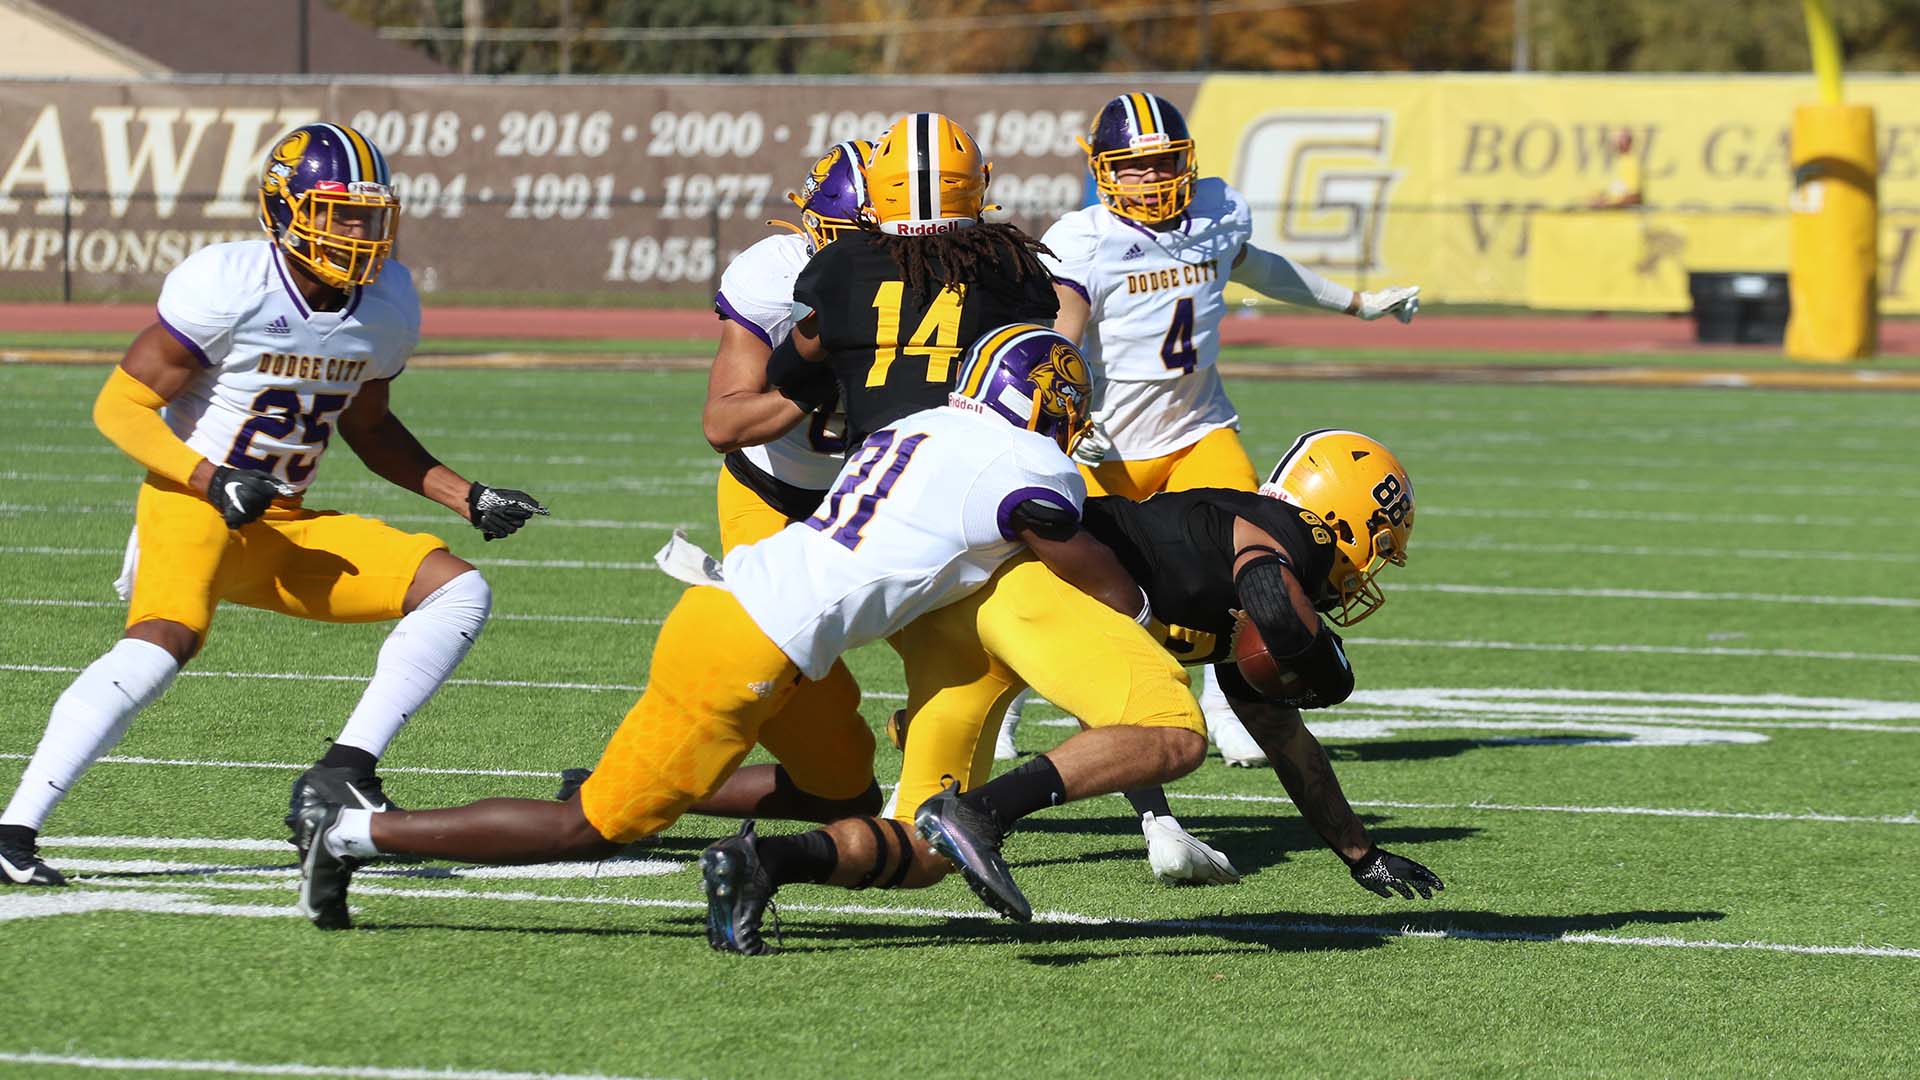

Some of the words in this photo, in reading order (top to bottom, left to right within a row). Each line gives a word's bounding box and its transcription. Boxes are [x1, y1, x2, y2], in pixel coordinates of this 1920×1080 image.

[350, 109, 460, 158] 2018
[496, 110, 613, 158] 2016
[647, 110, 764, 158] 2000
[801, 110, 911, 158] 199
[975, 109, 1086, 158] 1995
[1460, 119, 1678, 179] BOWL
[390, 172, 467, 219] 994
[506, 173, 615, 219] 1991
[658, 173, 773, 219] 1977
[983, 173, 1081, 220] 960
[897, 220, 959, 235] Riddell
[606, 236, 716, 282] 1955
[1127, 268, 1180, 294] DODGE
[1183, 260, 1218, 284] CITY
[865, 281, 967, 388] 14
[1158, 296, 1197, 376] 4
[257, 352, 324, 380] DODGE
[325, 358, 369, 382] CITY
[228, 386, 352, 485] 25
[1371, 472, 1411, 528] 88
